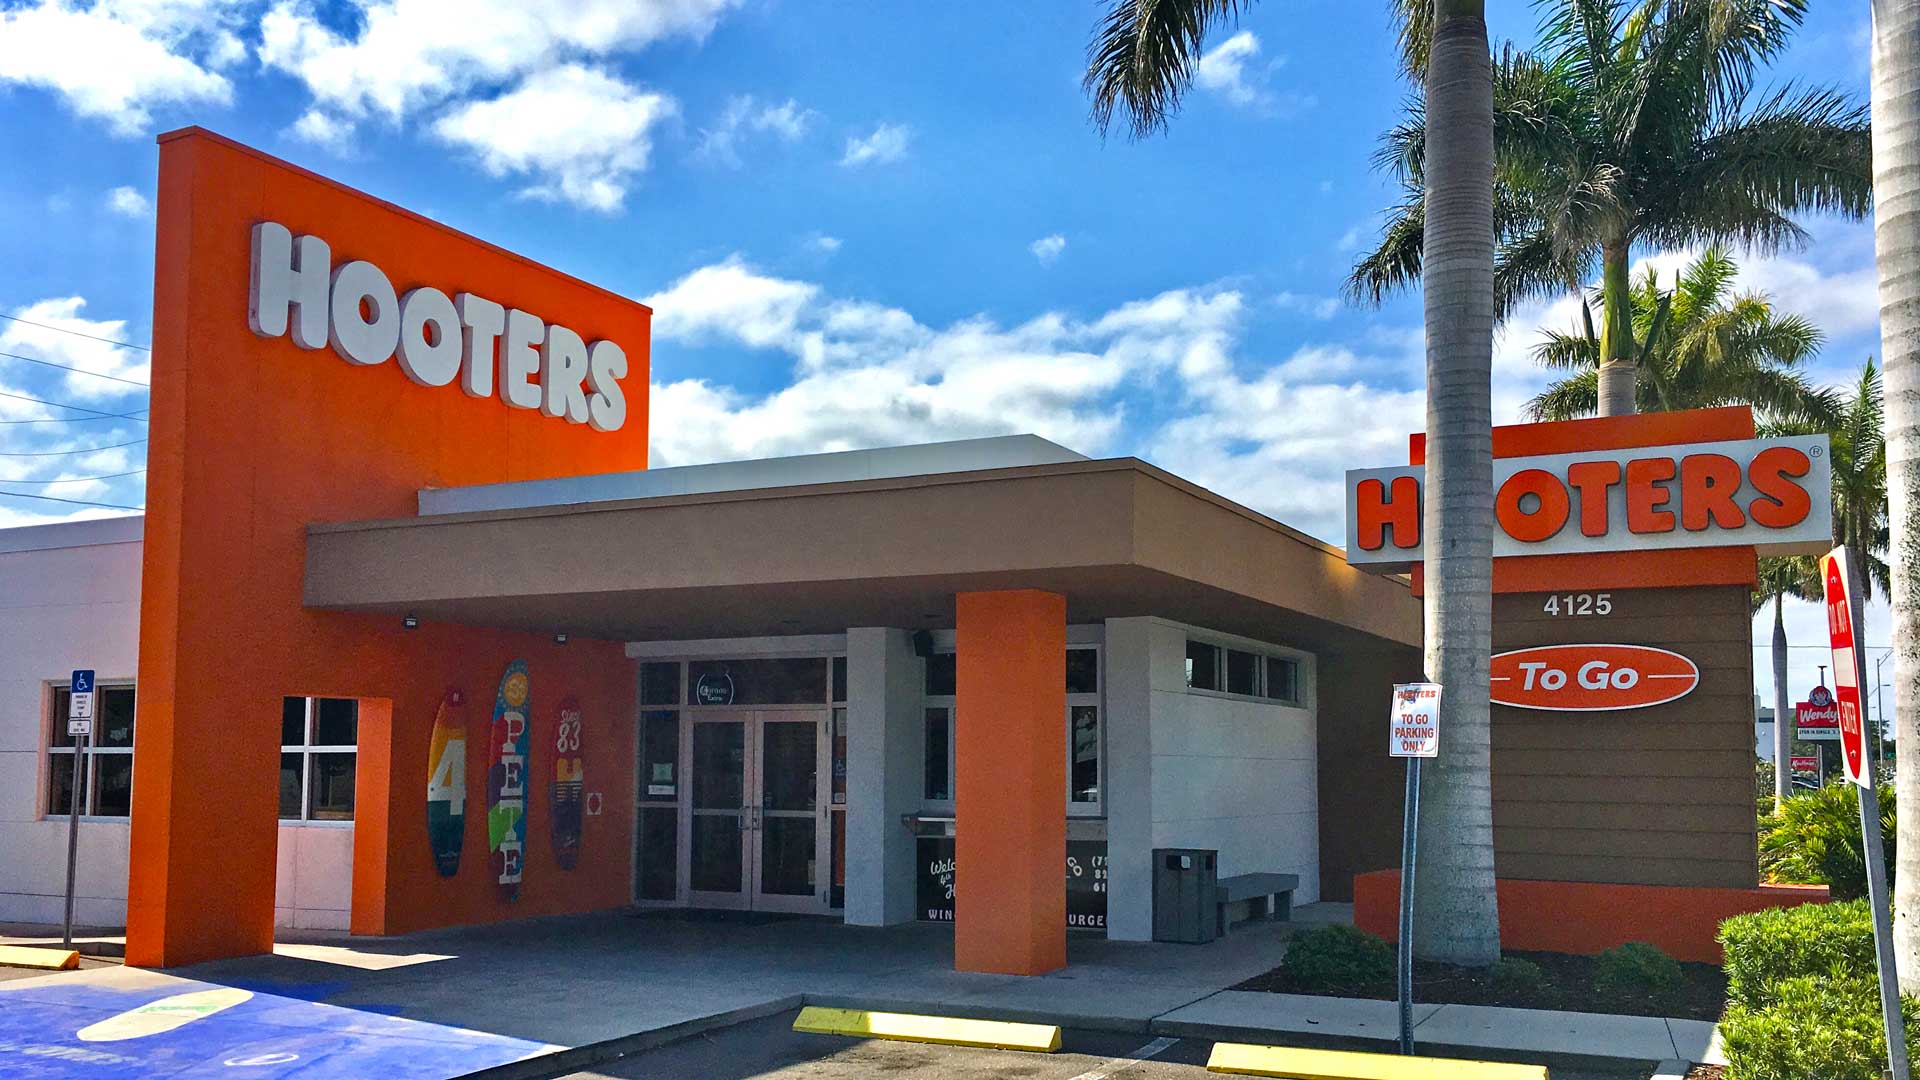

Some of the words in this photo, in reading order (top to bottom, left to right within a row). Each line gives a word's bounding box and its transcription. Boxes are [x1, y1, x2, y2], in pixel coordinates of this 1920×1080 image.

[248, 221, 629, 432] HOOTERS
[1356, 447, 1812, 551] HOTERS
[1543, 594, 1612, 616] 4125
[1518, 662, 1567, 690] To
[1577, 661, 1639, 690] Go
[1401, 714, 1413, 725] TO
[1415, 714, 1428, 725] GO
[1800, 706, 1839, 724] Wendy
[557, 721, 581, 753] 83
[1395, 727, 1434, 739] PARKING
[1401, 740, 1426, 752] ONLY
[498, 711, 526, 884] PETE
[930, 857, 956, 875] Welc
[1067, 856, 1083, 877] GO
[1094, 869, 1107, 879] 82
[1093, 882, 1106, 893] 61
[928, 909, 955, 920] WIN
[1068, 914, 1104, 926] URGE
